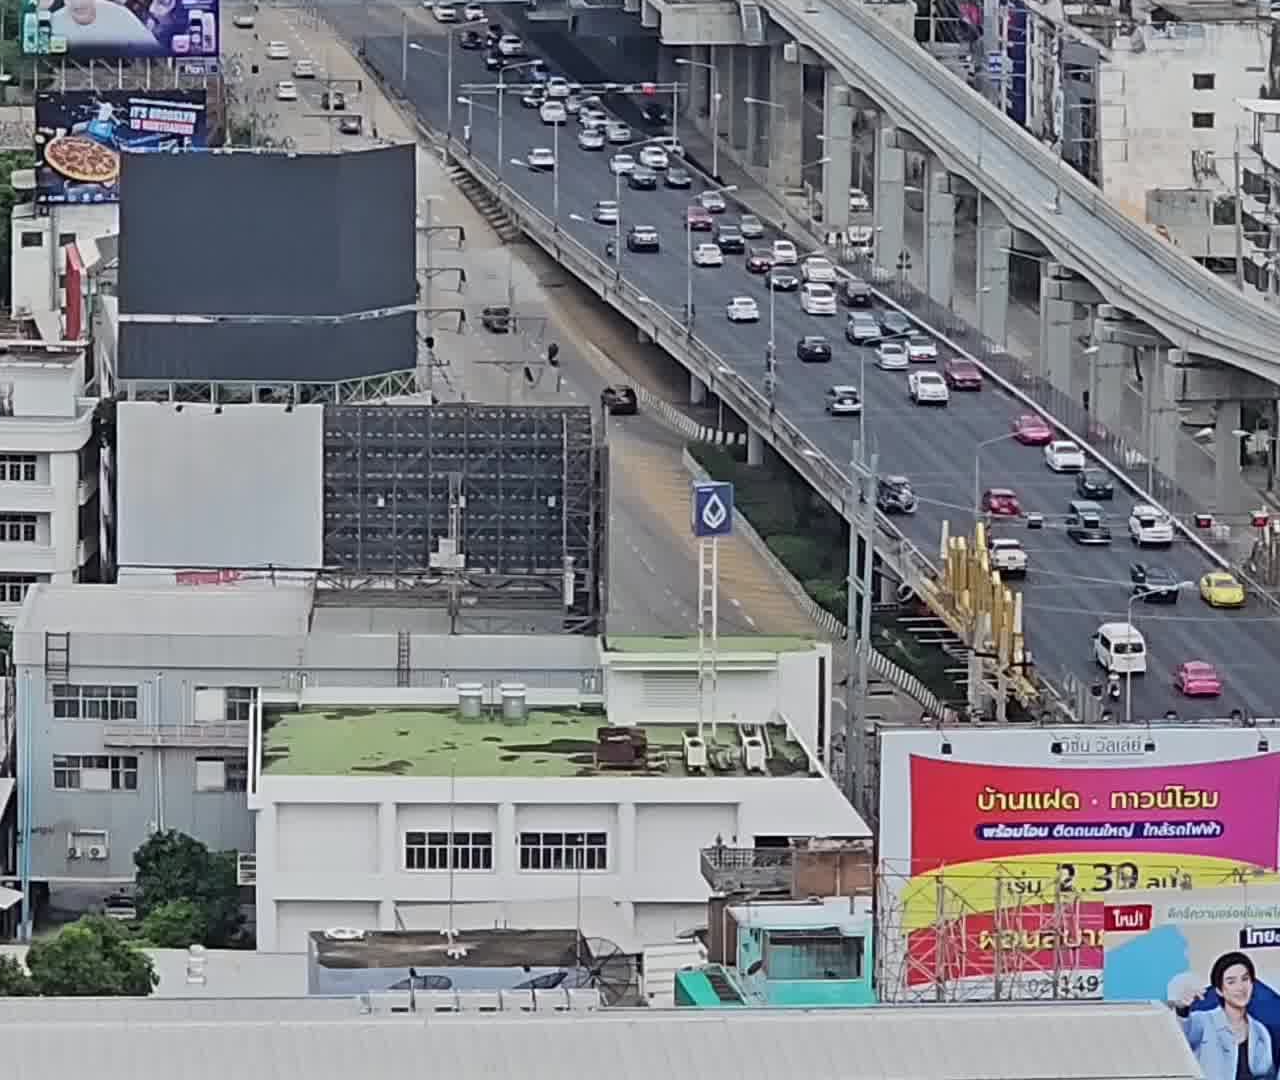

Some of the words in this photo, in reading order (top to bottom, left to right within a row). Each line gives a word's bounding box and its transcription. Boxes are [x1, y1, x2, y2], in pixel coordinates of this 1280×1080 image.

[977, 787, 1080, 810] บ้านแฝด
[1110, 786, 1219, 809] ทาวน์โฮม
[983, 824, 1049, 838] พร้อมโอน
[1052, 823, 1134, 839] ติดถนนใหญ่
[1143, 821, 1221, 837] ใกล้รถไฟฟ้า
[1056, 862, 1139, 893] 2.39
